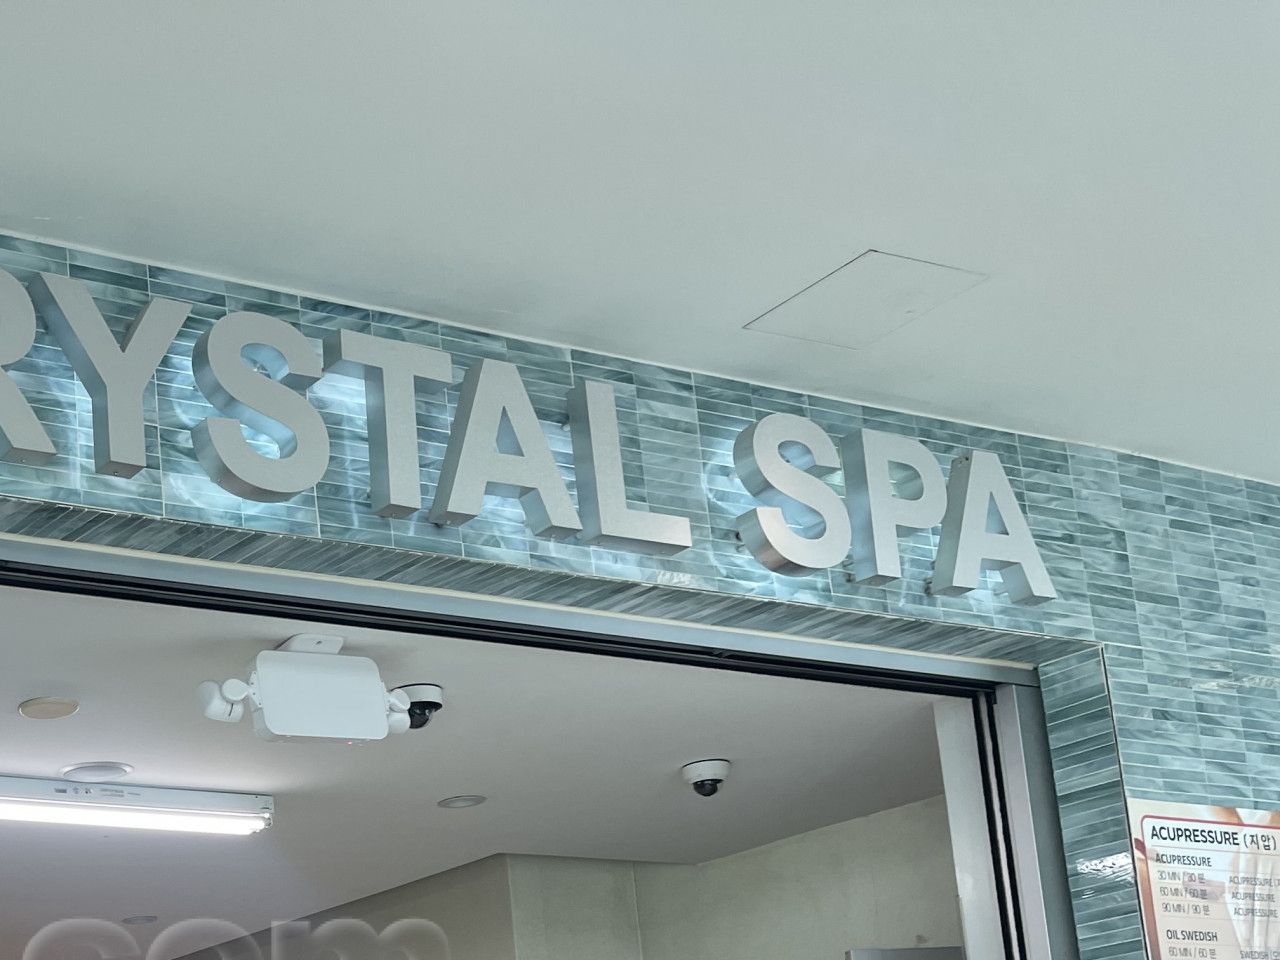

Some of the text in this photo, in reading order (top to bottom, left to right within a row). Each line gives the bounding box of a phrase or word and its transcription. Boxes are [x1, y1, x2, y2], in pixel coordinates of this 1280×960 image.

[733, 411, 1057, 600] SPA
[1151, 826, 1239, 845] ACUPRESSURE
[1156, 854, 1212, 867] ACUPRESSURE
[1166, 929, 1218, 942] OIL SWEDISH
